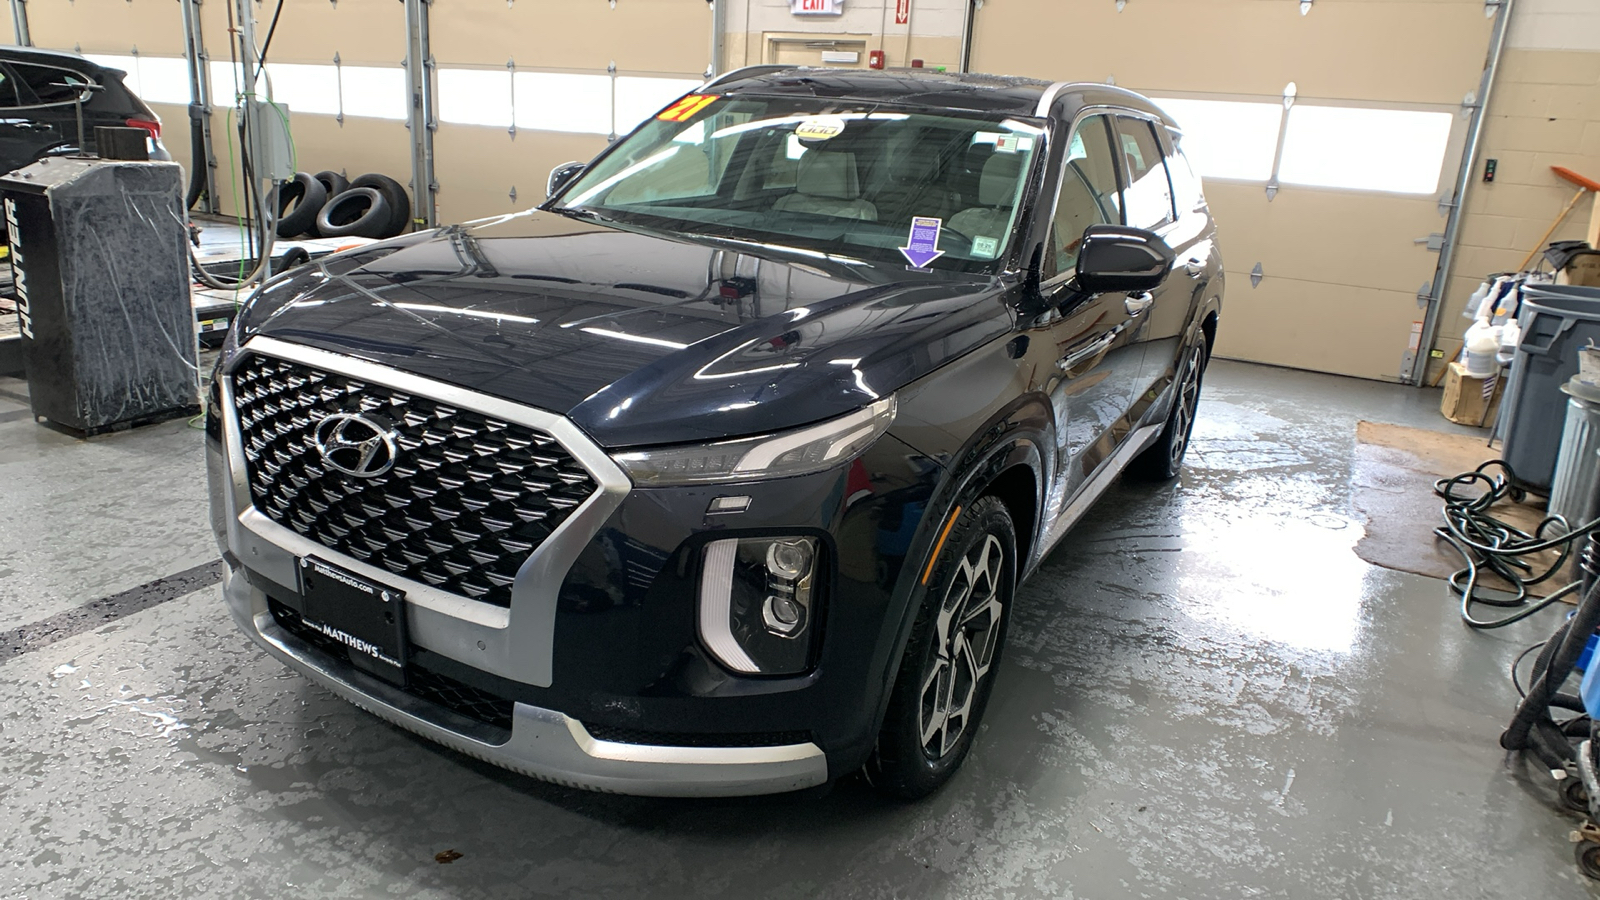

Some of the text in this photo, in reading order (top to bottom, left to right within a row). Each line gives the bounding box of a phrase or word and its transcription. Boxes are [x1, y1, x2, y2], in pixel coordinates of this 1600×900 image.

[657, 95, 718, 121] 21
[4, 197, 34, 340] HUNTER
[314, 565, 373, 594] MatthewsAuto.com
[323, 624, 379, 658] MATTHEWS
